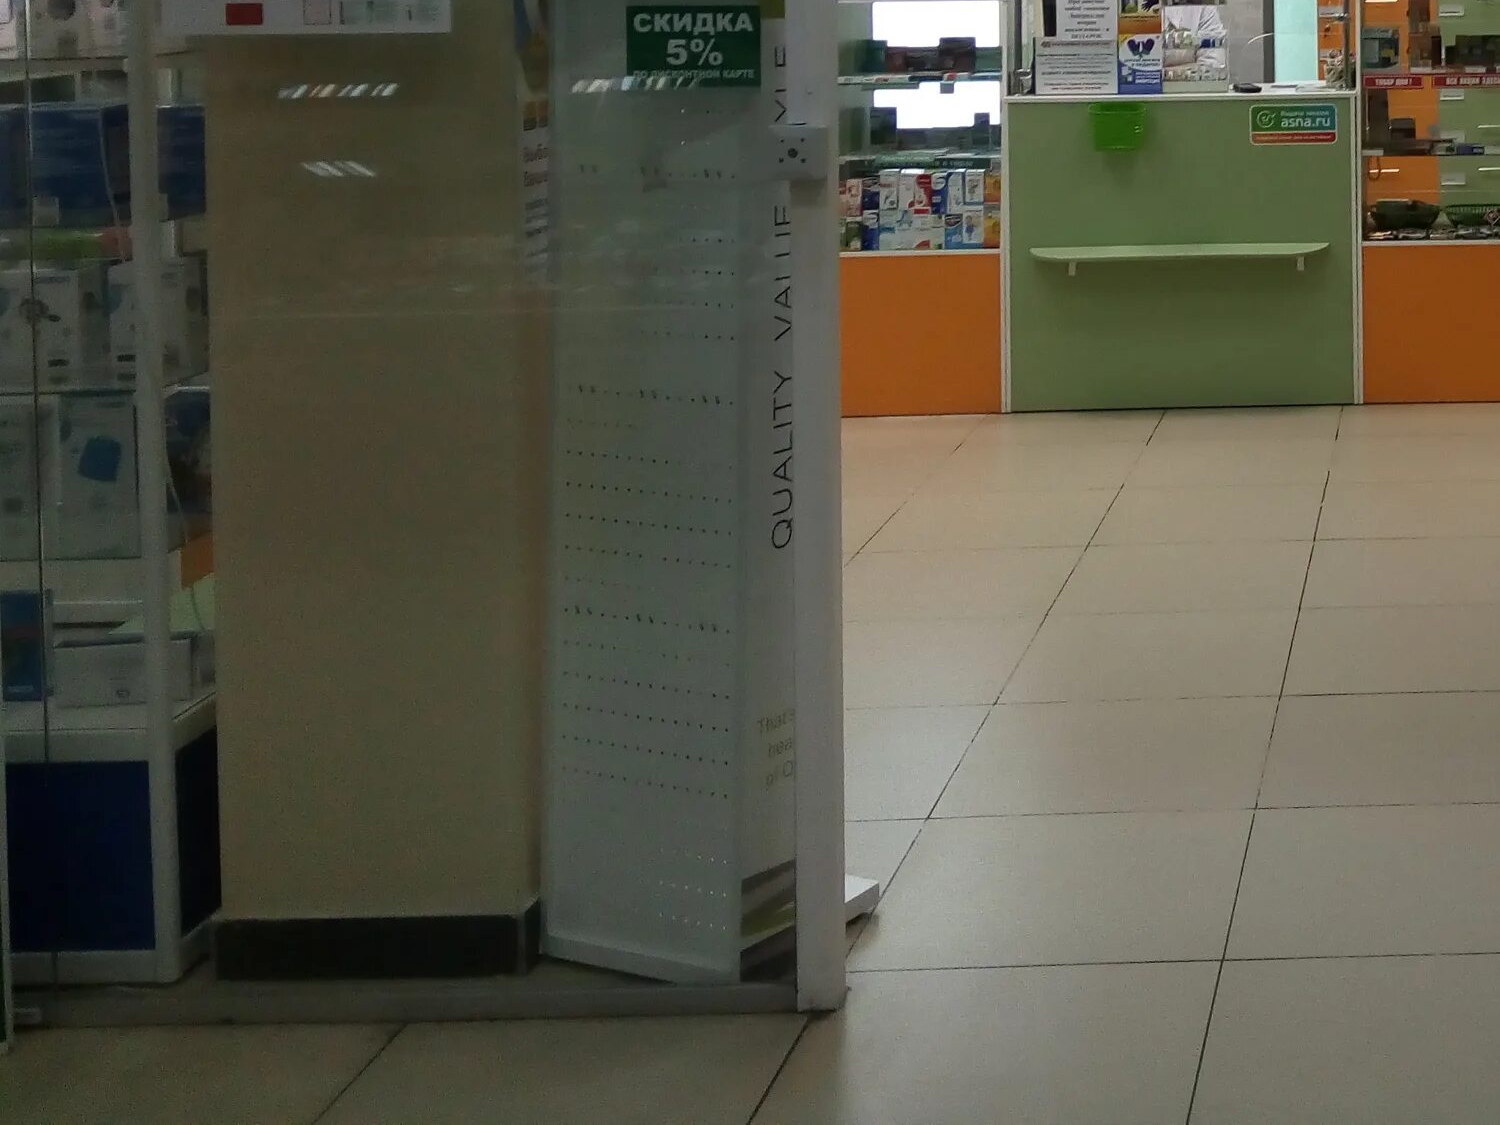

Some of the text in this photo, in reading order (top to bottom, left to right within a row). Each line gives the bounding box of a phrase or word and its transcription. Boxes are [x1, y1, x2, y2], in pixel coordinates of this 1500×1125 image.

[632, 12, 754, 36] СКИДКА
[665, 37, 724, 66] 5%
[1280, 117, 1331, 129] asna.ru
[770, 369, 793, 550] QUALITY
